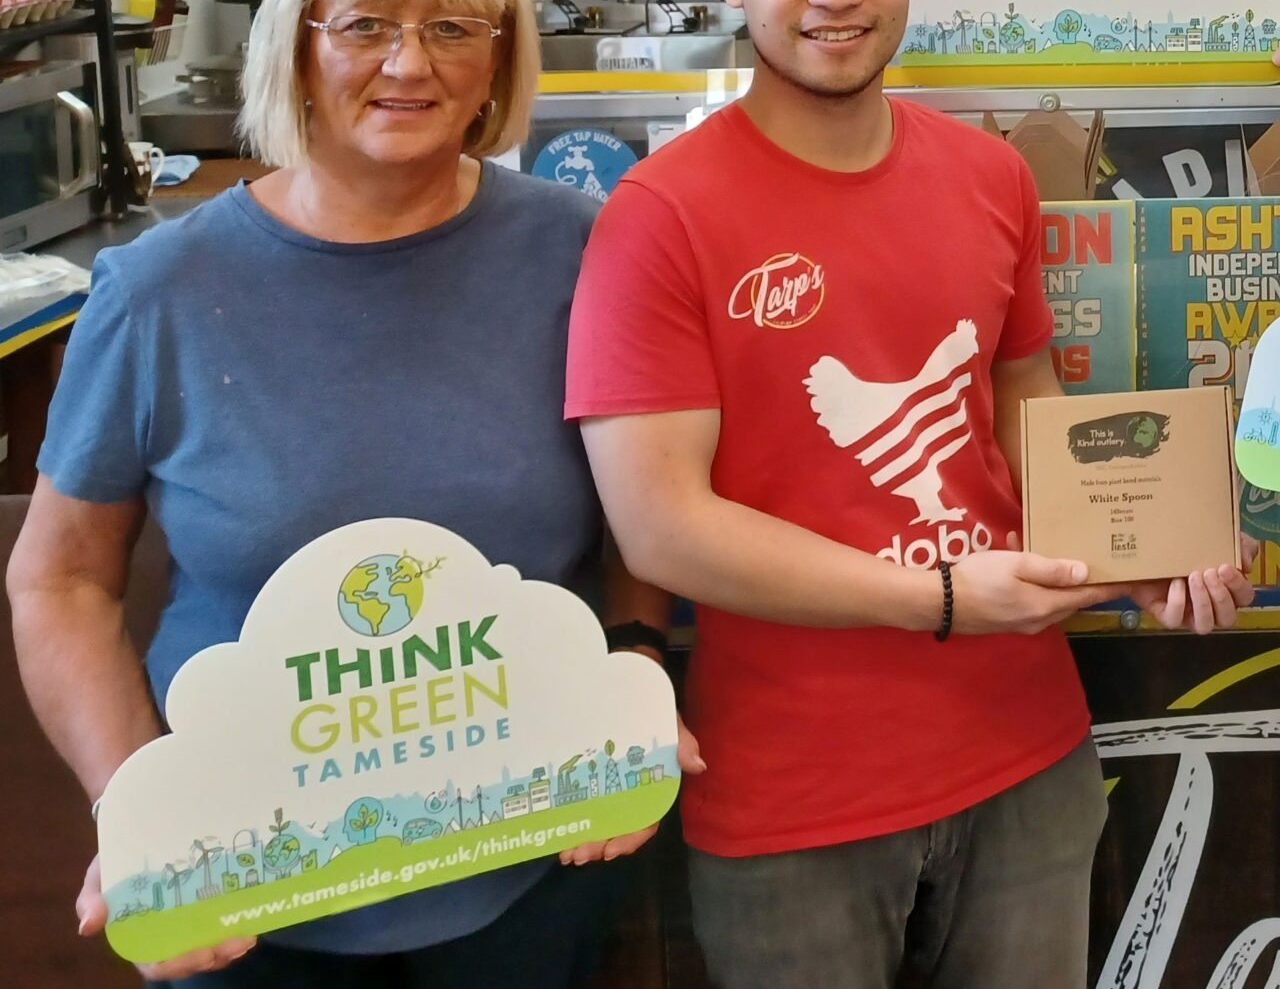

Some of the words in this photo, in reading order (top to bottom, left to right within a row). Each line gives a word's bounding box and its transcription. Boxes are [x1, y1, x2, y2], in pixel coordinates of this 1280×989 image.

[548, 135, 572, 155] FREE
[573, 131, 591, 141] TAP
[593, 132, 621, 151] WATER
[1077, 439, 1094, 447] Kind
[1090, 430, 1106, 438] This
[1089, 493, 1119, 504] White
[1122, 493, 1153, 503] Spoon
[290, 665, 510, 755] GREEN
[293, 718, 511, 787] TAMESIDE
[220, 817, 591, 927] www.tameside.gov.uk/thinkgreen
